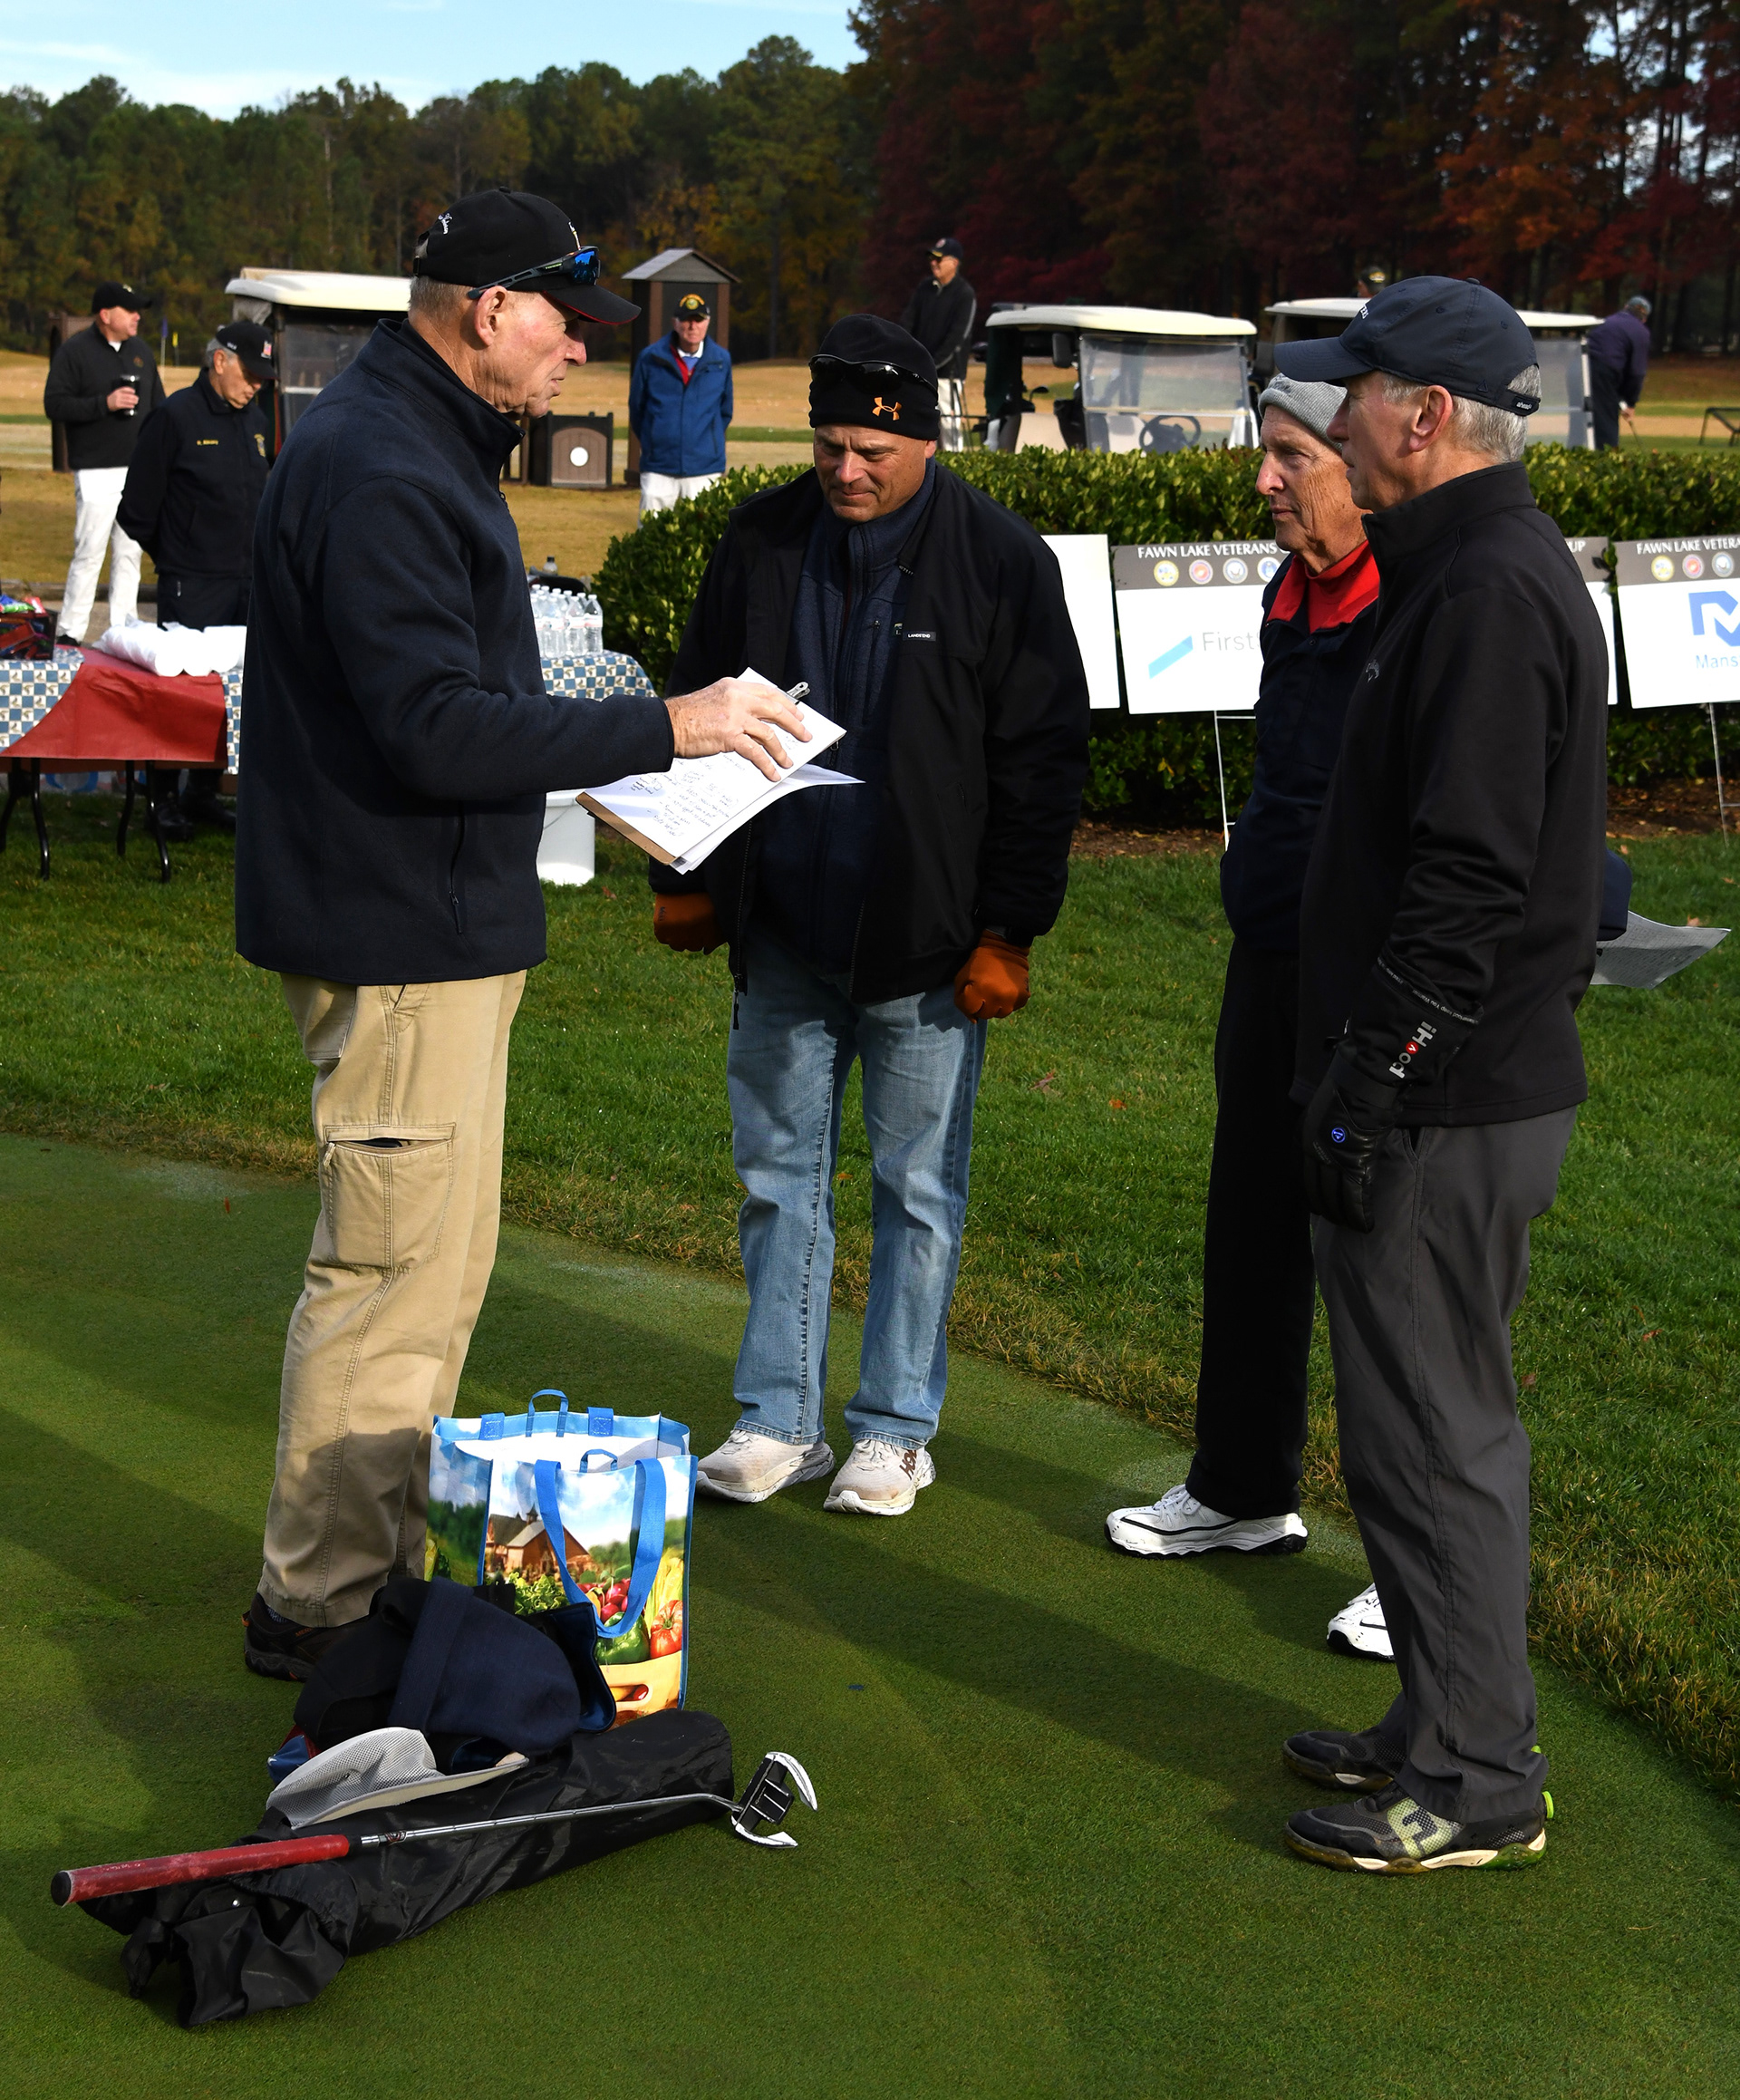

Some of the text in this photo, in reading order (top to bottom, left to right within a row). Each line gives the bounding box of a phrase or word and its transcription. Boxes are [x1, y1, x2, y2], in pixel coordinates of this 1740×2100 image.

[1138, 543, 1277, 558] FAWN LAKE VETERANS
[1637, 541, 1672, 555] FAWN
[1674, 539, 1701, 553] LAKE
[1202, 632, 1259, 651] First
[1696, 654, 1740, 669] Mans
